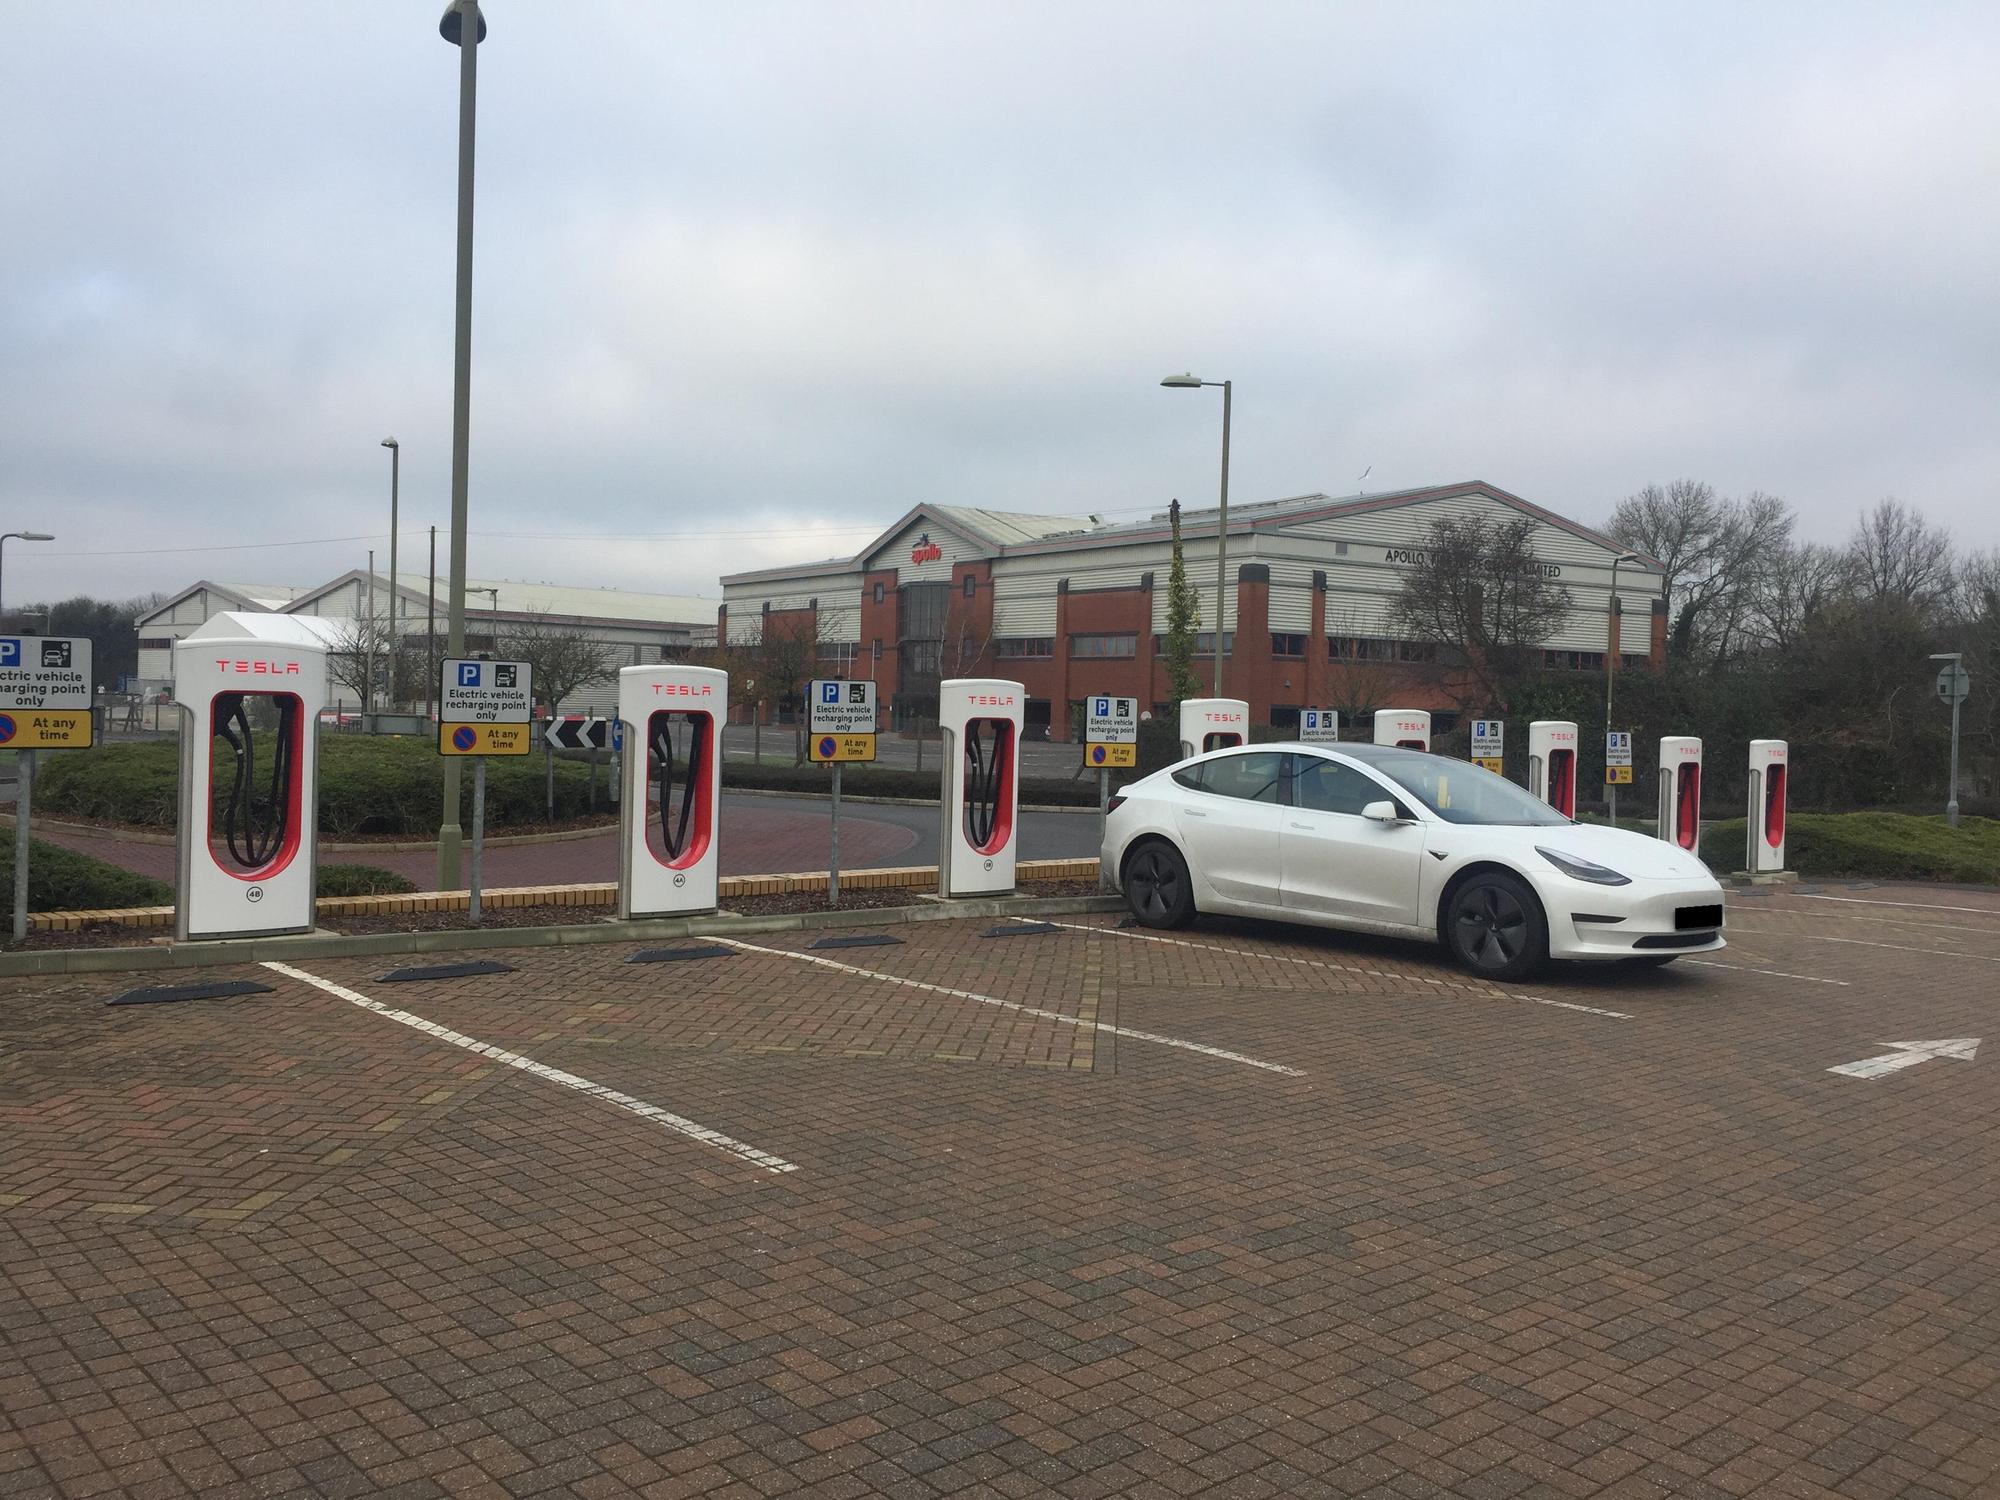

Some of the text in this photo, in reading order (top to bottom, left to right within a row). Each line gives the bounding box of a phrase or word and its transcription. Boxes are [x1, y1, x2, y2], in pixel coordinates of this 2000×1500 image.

[1385, 549, 1425, 564] APOLLO
[0, 642, 15, 665] P
[216, 660, 299, 674] TESLA
[0, 671, 82, 681] ctric vehicle
[463, 666, 477, 684] P
[51, 684, 86, 695] point
[450, 690, 524, 699] Electric vehicle
[652, 685, 711, 696] TESLA
[826, 685, 836, 701] P
[15, 696, 44, 707] only
[446, 700, 526, 710] recharging point
[968, 696, 1013, 705] TESLA
[816, 705, 845, 713] Electric
[1099, 701, 1106, 714] P
[476, 711, 497, 720] only
[1205, 713, 1240, 722] TESLA
[33, 718, 76, 729] At any
[40, 730, 69, 740] time
[488, 729, 519, 740] At any
[1088, 726, 1119, 734] recharging
[492, 740, 514, 748] time
[848, 747, 864, 755] time
[249, 890, 260, 898] 4B
